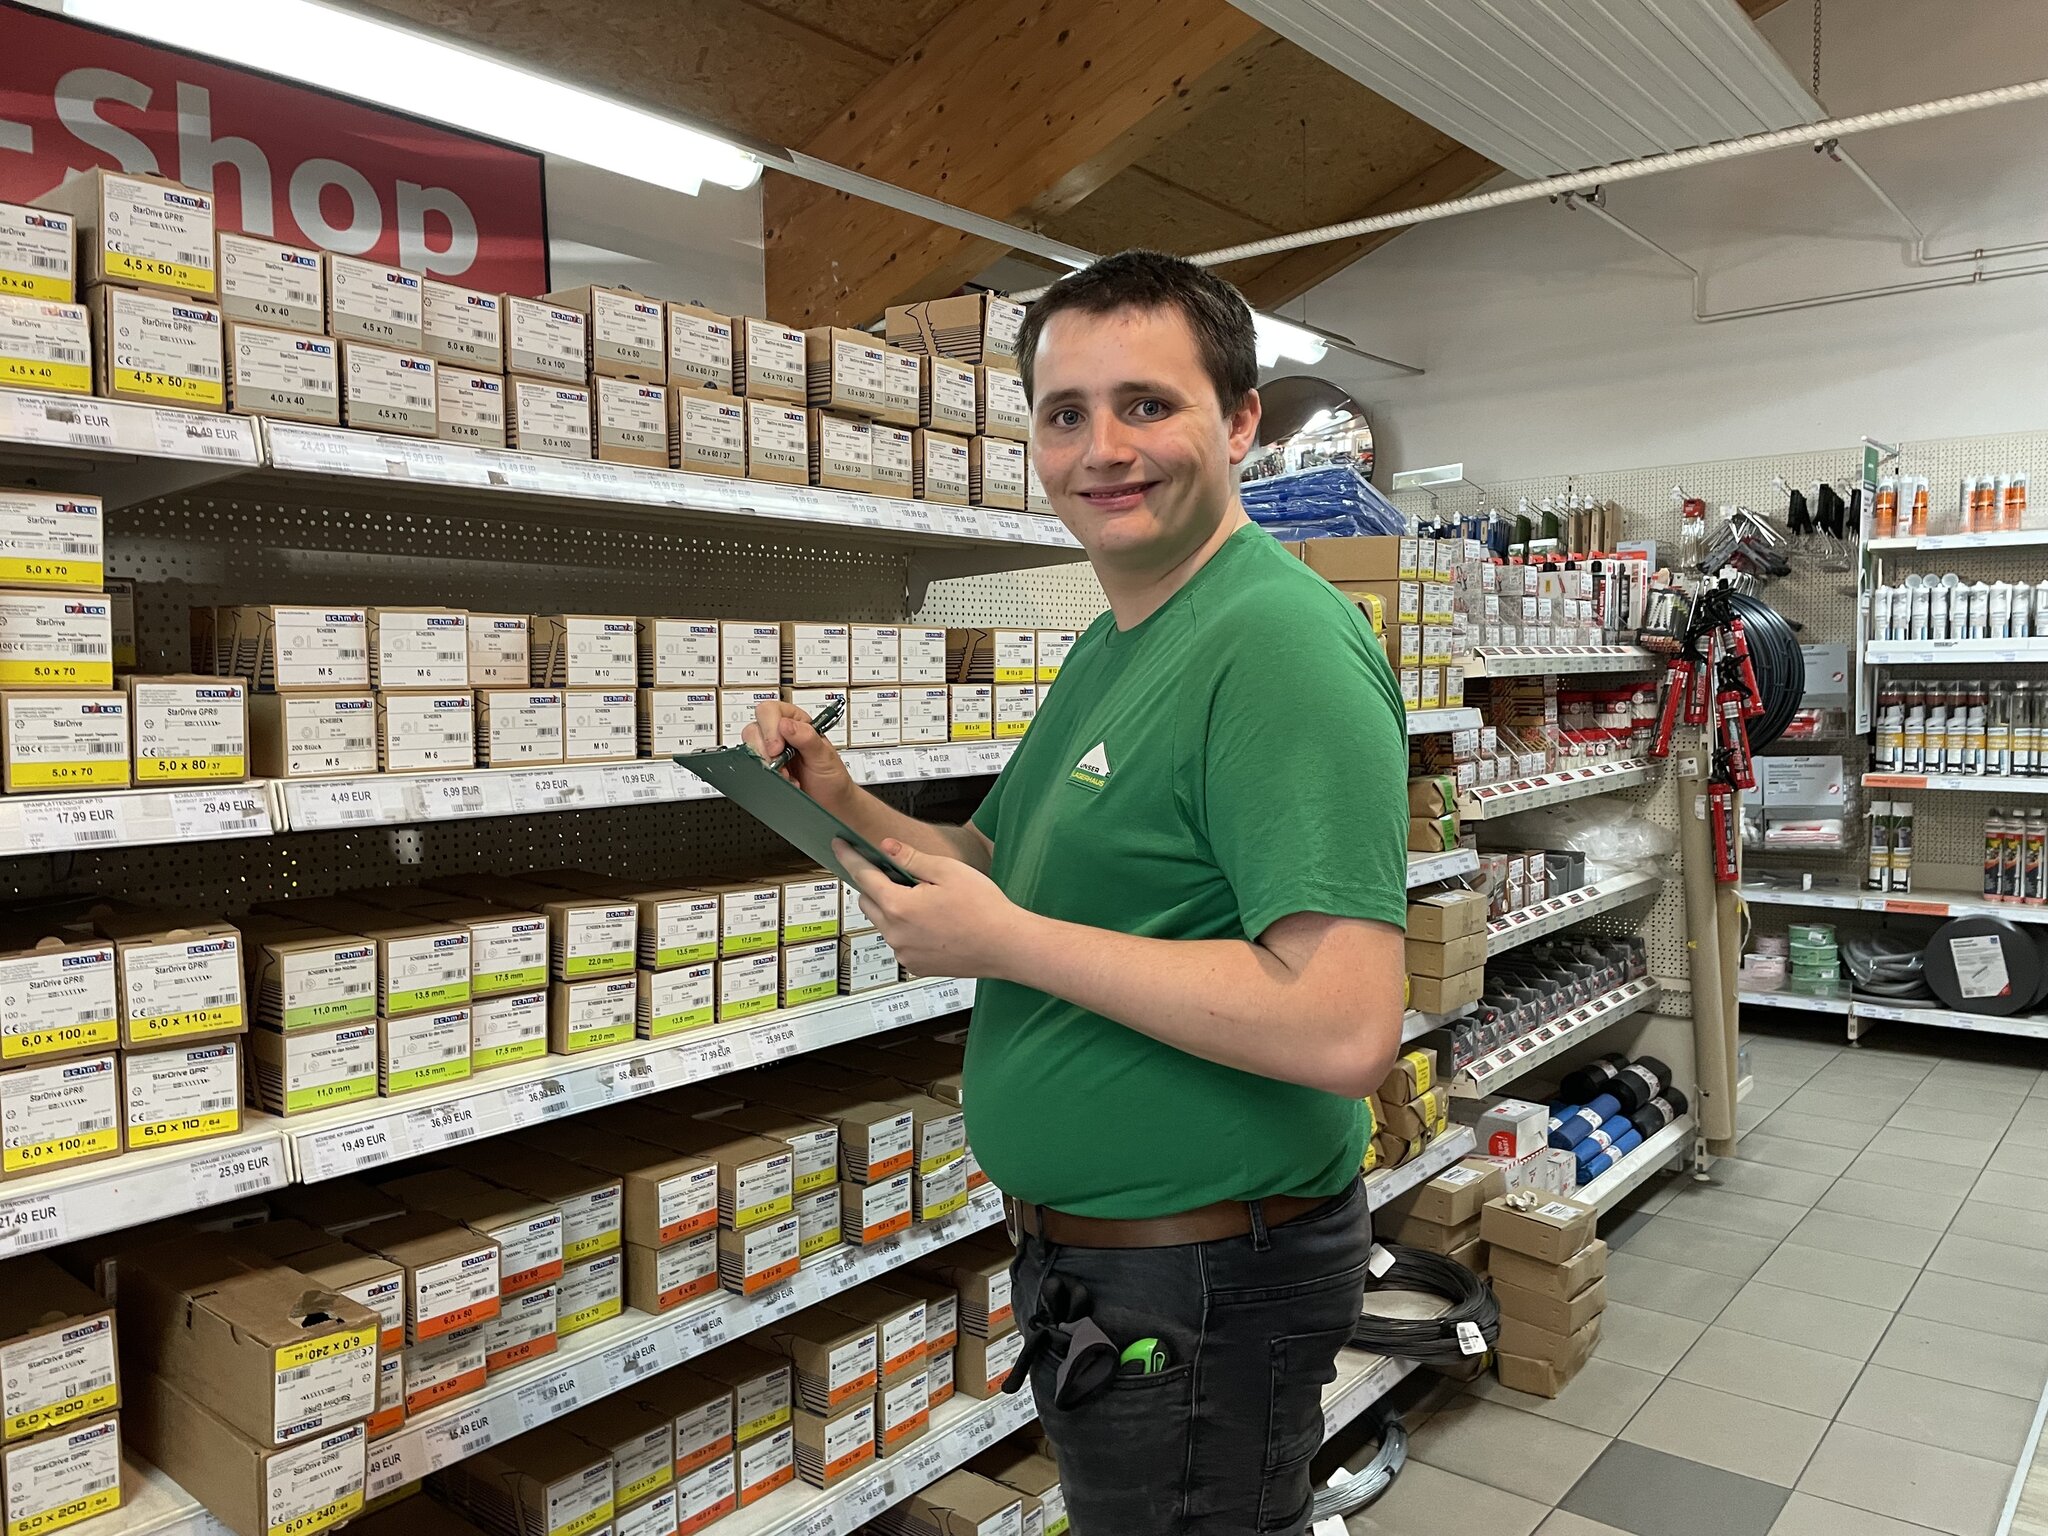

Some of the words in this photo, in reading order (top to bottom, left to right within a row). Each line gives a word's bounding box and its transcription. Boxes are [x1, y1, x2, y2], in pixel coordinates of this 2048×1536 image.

[164, 192, 210, 210] schmid
[133, 205, 163, 219] StarDrive
[124, 258, 143, 270] 4,5
[158, 265, 172, 276] 50
[21, 279, 34, 289] 40
[172, 307, 218, 323] schmid
[278, 307, 289, 317] 40
[11, 317, 41, 329] StarDrive
[142, 316, 172, 329] StarDrive
[384, 326, 393, 335] 70
[466, 345, 475, 353] 80
[9, 365, 26, 374] 4,5
[39, 368, 51, 377] 40
[553, 361, 565, 369] 100
[134, 371, 152, 383] 4,5
[168, 376, 182, 387] 50
[294, 396, 305, 406] 40
[85, 415, 110, 427] EUR
[399, 412, 408, 421] 70
[216, 429, 239, 441] EUR
[328, 444, 350, 456] EUR
[558, 440, 571, 448] 100
[426, 455, 445, 465] EUR
[602, 475, 618, 484] EUR
[27, 516, 57, 525] StarDrive
[26, 565, 42, 575] 5,0
[55, 567, 68, 575] 70
[36, 618, 66, 627] StarDrive
[325, 613, 364, 623] schmid
[427, 617, 464, 626] schmid
[494, 620, 525, 629] schmid
[34, 668, 51, 677] 5,0
[63, 667, 76, 676] 70
[318, 668, 327, 676] M
[417, 669, 425, 677] M
[196, 687, 242, 699] schmid
[335, 700, 372, 710] schmid
[434, 699, 469, 708] schmid
[167, 708, 197, 716] StarDrive
[53, 720, 83, 728] StarDrive
[292, 744, 303, 752] 200
[304, 743, 322, 751] Stück
[159, 761, 177, 772] 5,0
[192, 760, 206, 771] 80
[325, 759, 334, 767] M
[892, 758, 903, 766] EUR
[52, 768, 68, 778] 5,0
[80, 767, 93, 776] 70
[622, 775, 639, 783] 10,99
[641, 773, 655, 782] EUR
[536, 781, 551, 790] 6,29
[553, 779, 568, 788] EUR
[331, 792, 350, 803] 4,49
[352, 791, 372, 801] EUR
[443, 787, 460, 798] 6,99
[462, 786, 480, 795] EUR
[203, 802, 231, 814] 29,49
[232, 800, 256, 811] EUR
[56, 811, 88, 825] 17,99
[90, 809, 114, 821] EUR
[187, 940, 235, 955] schmid
[62, 951, 112, 967] schmid
[335, 948, 373, 960] schmid
[588, 958, 601, 966] 22,0
[602, 956, 614, 964] mm
[155, 965, 187, 974] StarDrive
[495, 973, 509, 982] 17,5
[29, 978, 61, 990] StarDrive
[414, 990, 430, 1000] 13,5
[431, 988, 445, 996] mm
[313, 1005, 330, 1016] 11,0
[332, 1003, 347, 1012] mm
[900, 1000, 910, 1009] EUR
[149, 1017, 168, 1030] 6,0
[185, 1012, 207, 1024] 110
[21, 1035, 42, 1048] 6,0
[58, 1029, 81, 1041] 100
[589, 1033, 602, 1042] 22,0
[766, 1036, 782, 1045] 25,99
[782, 1030, 795, 1039] EUR
[187, 1047, 234, 1062] schmid
[701, 1051, 718, 1062] 27,99
[718, 1046, 731, 1057] EUR
[414, 1069, 430, 1078] 13,5
[638, 1065, 653, 1076] EUR
[317, 1086, 333, 1097] 11,0
[335, 1084, 351, 1093] mm
[551, 1084, 566, 1096] EUR
[30, 1092, 62, 1102] StarDrive
[431, 1115, 453, 1128] 36,99
[454, 1110, 473, 1121] EUR
[144, 1124, 167, 1136] 6,0
[182, 1118, 199, 1129] 110
[342, 1138, 365, 1152] 19,49
[367, 1132, 387, 1146] EUR
[22, 1147, 41, 1160] 6,0
[58, 1139, 81, 1151] 100
[219, 1162, 245, 1178] 25,99
[248, 1156, 269, 1170] EUR
[32, 1206, 57, 1222] EUR
[709, 1317, 723, 1329] EUR
[641, 1343, 656, 1357] EUR
[28, 1354, 64, 1369] StarDrive
[16, 1414, 40, 1429] 6,0
[55, 1399, 83, 1417] 200
[471, 1417, 489, 1431] EUR
[383, 1453, 402, 1469] EUR
[19, 1517, 42, 1532] 6,0
[58, 1501, 87, 1519] 200
[285, 1519, 304, 1533] 6,0
[317, 1505, 336, 1520] 240
